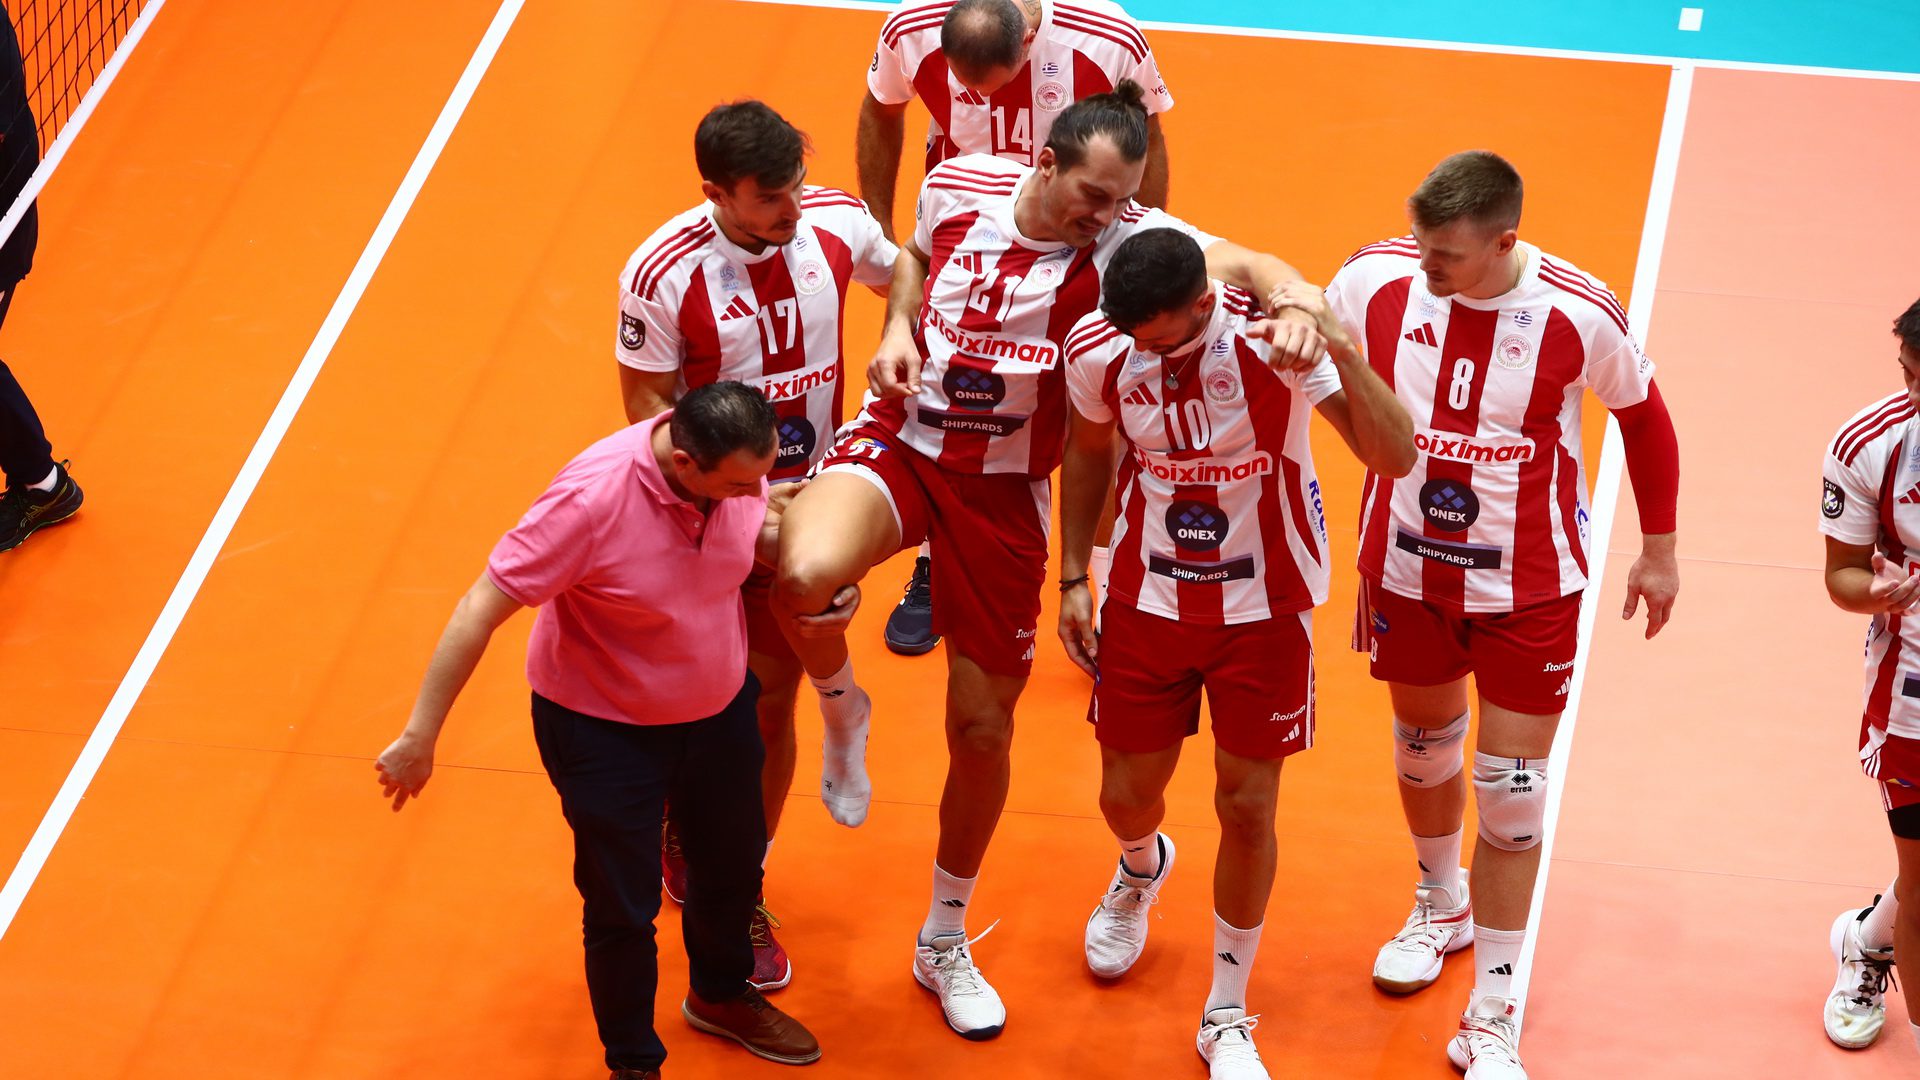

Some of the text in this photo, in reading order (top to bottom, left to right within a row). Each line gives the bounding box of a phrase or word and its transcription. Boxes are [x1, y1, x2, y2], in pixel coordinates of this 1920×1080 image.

[992, 106, 1032, 151] 14
[968, 268, 1023, 322] 21
[757, 297, 798, 355] 17
[929, 309, 1055, 365] Stoiximan
[763, 362, 838, 401] ixima
[955, 390, 994, 400] ONEX
[1449, 358, 1475, 410] 8
[941, 419, 1003, 433] SHIPYARDS
[1165, 399, 1211, 450] 10
[777, 444, 804, 458] NEX
[1414, 433, 1532, 462] oiximan
[1137, 448, 1268, 482] Stoiximan
[1825, 481, 1836, 491] CEV
[1428, 507, 1466, 523] ONEX
[1177, 528, 1217, 541] ONEX
[1417, 545, 1474, 566] SHIPYARDS
[1172, 567, 1229, 581] SHIPYARDS
